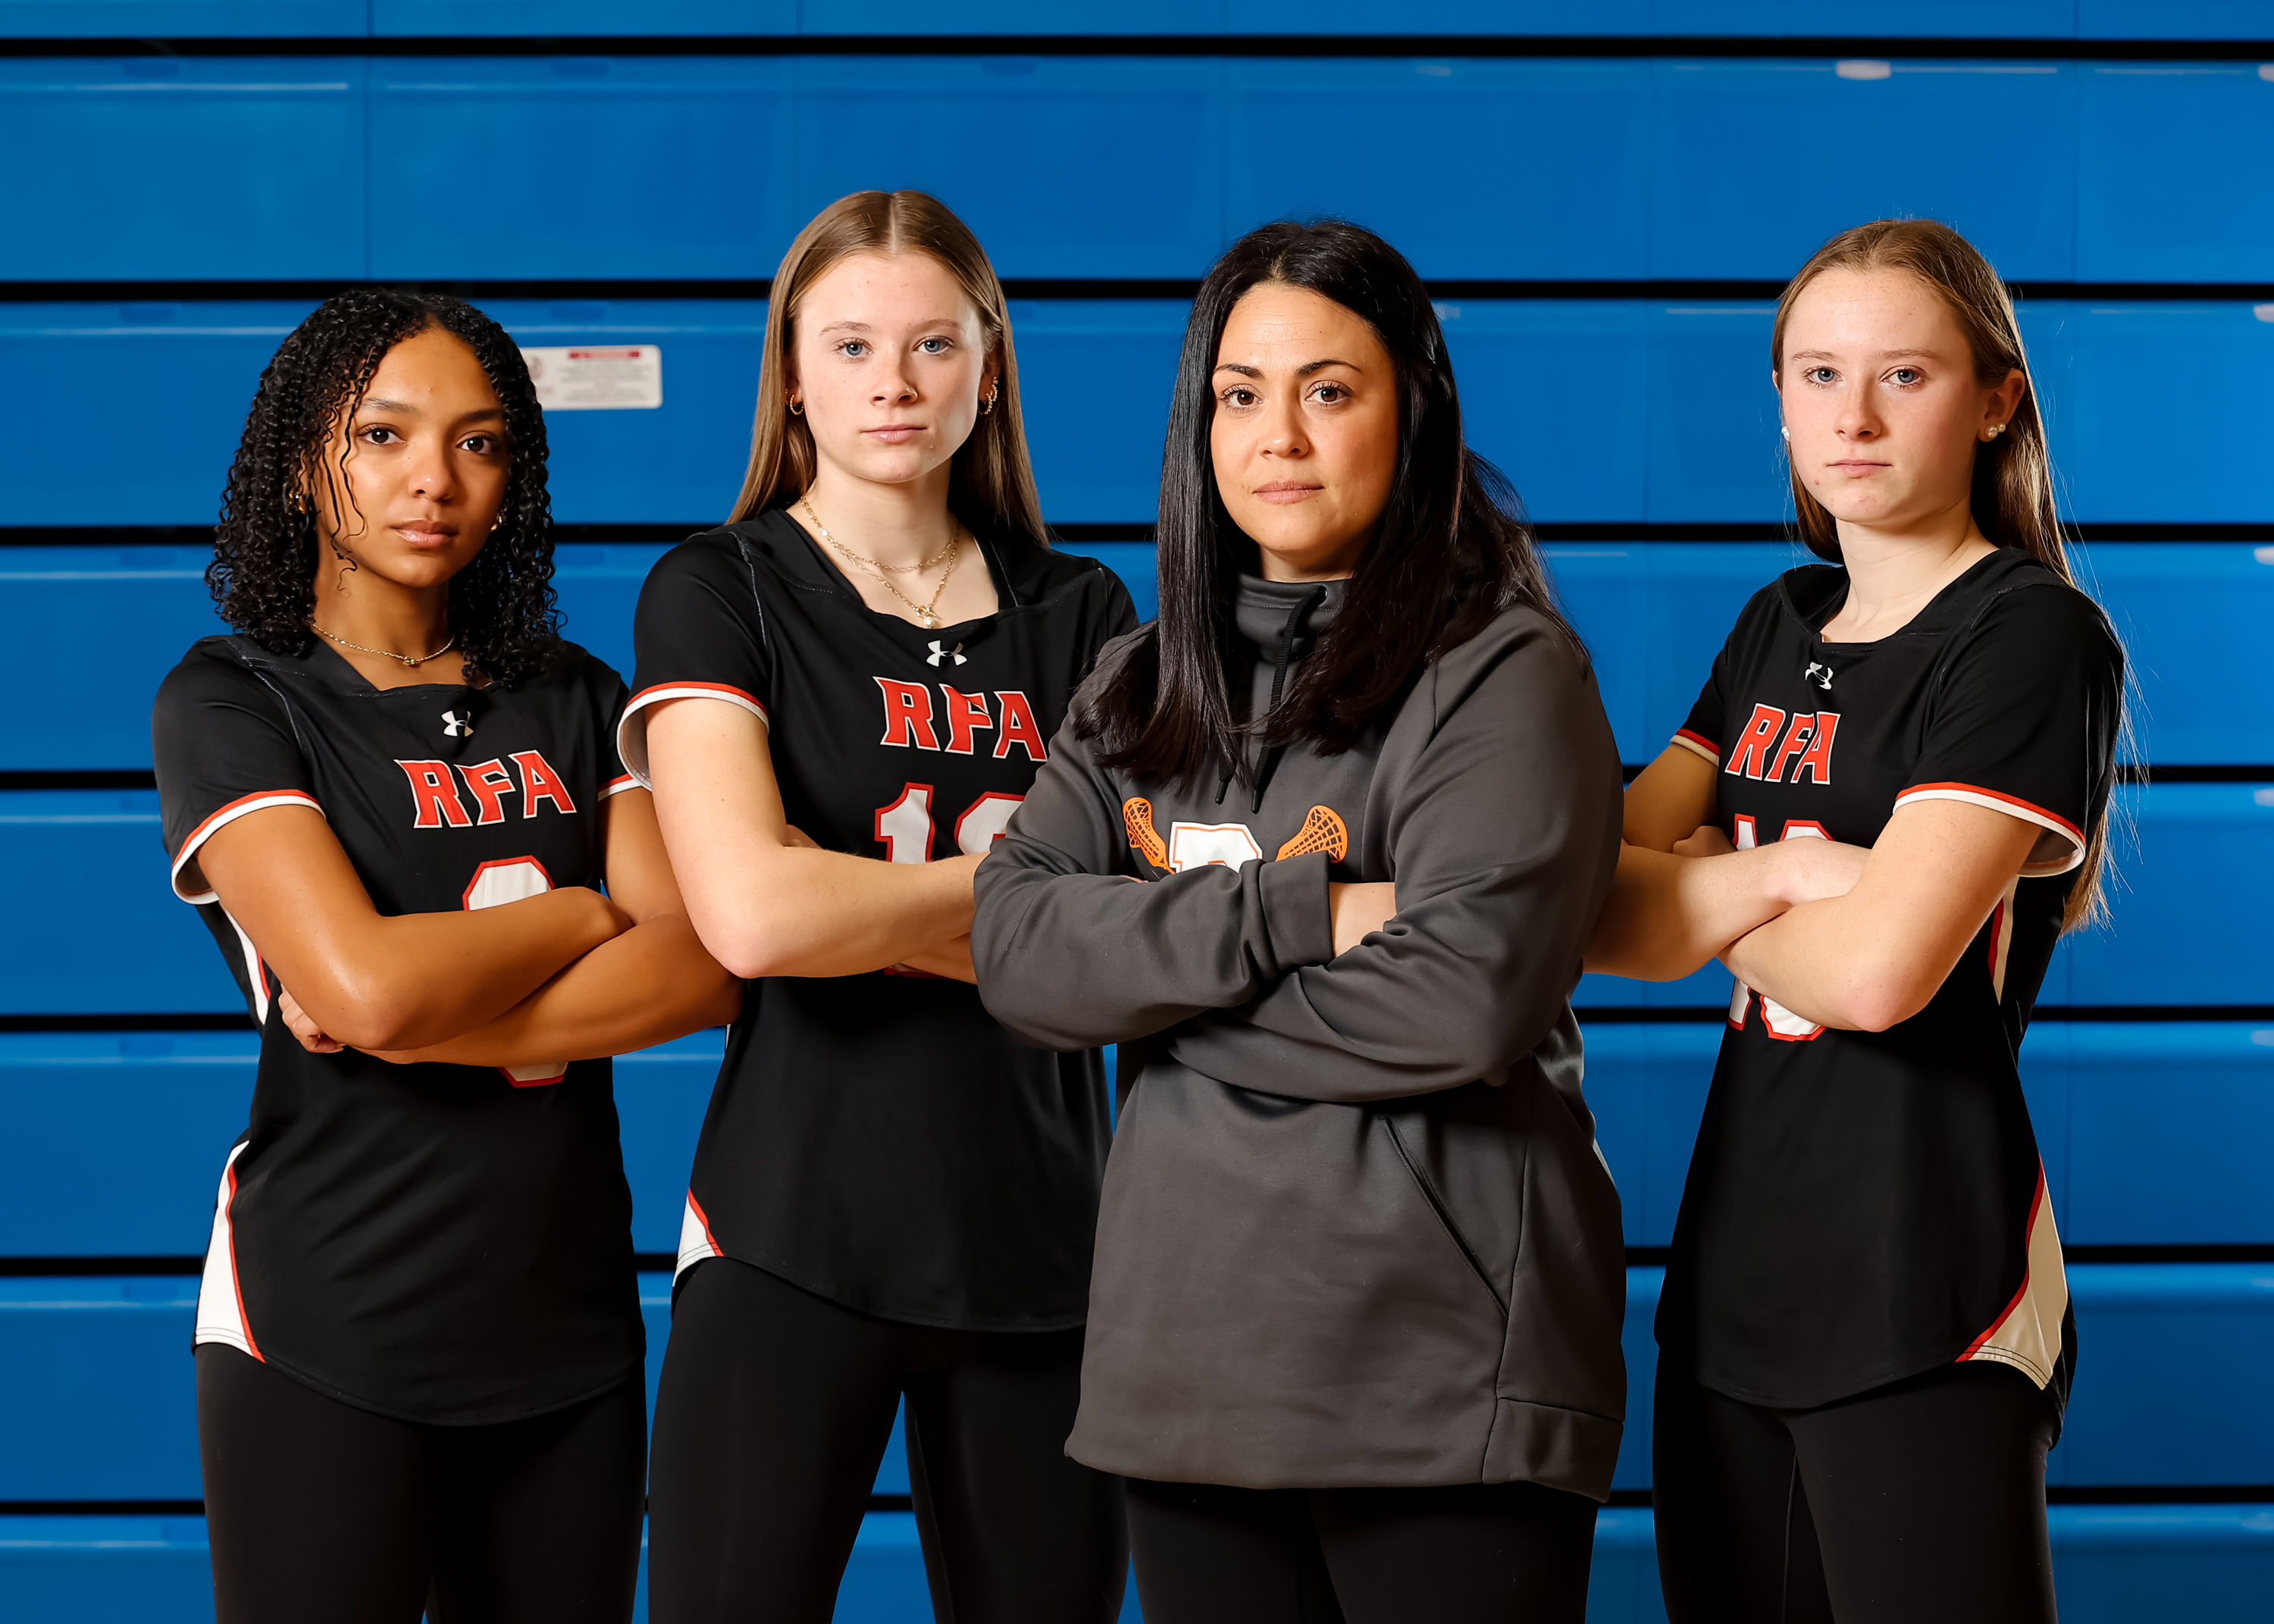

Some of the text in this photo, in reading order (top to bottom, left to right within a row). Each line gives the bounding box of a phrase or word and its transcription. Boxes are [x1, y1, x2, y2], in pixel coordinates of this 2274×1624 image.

[872, 676, 1048, 762] RFA
[1724, 703, 1841, 784] RFA
[393, 749, 577, 828] RFA
